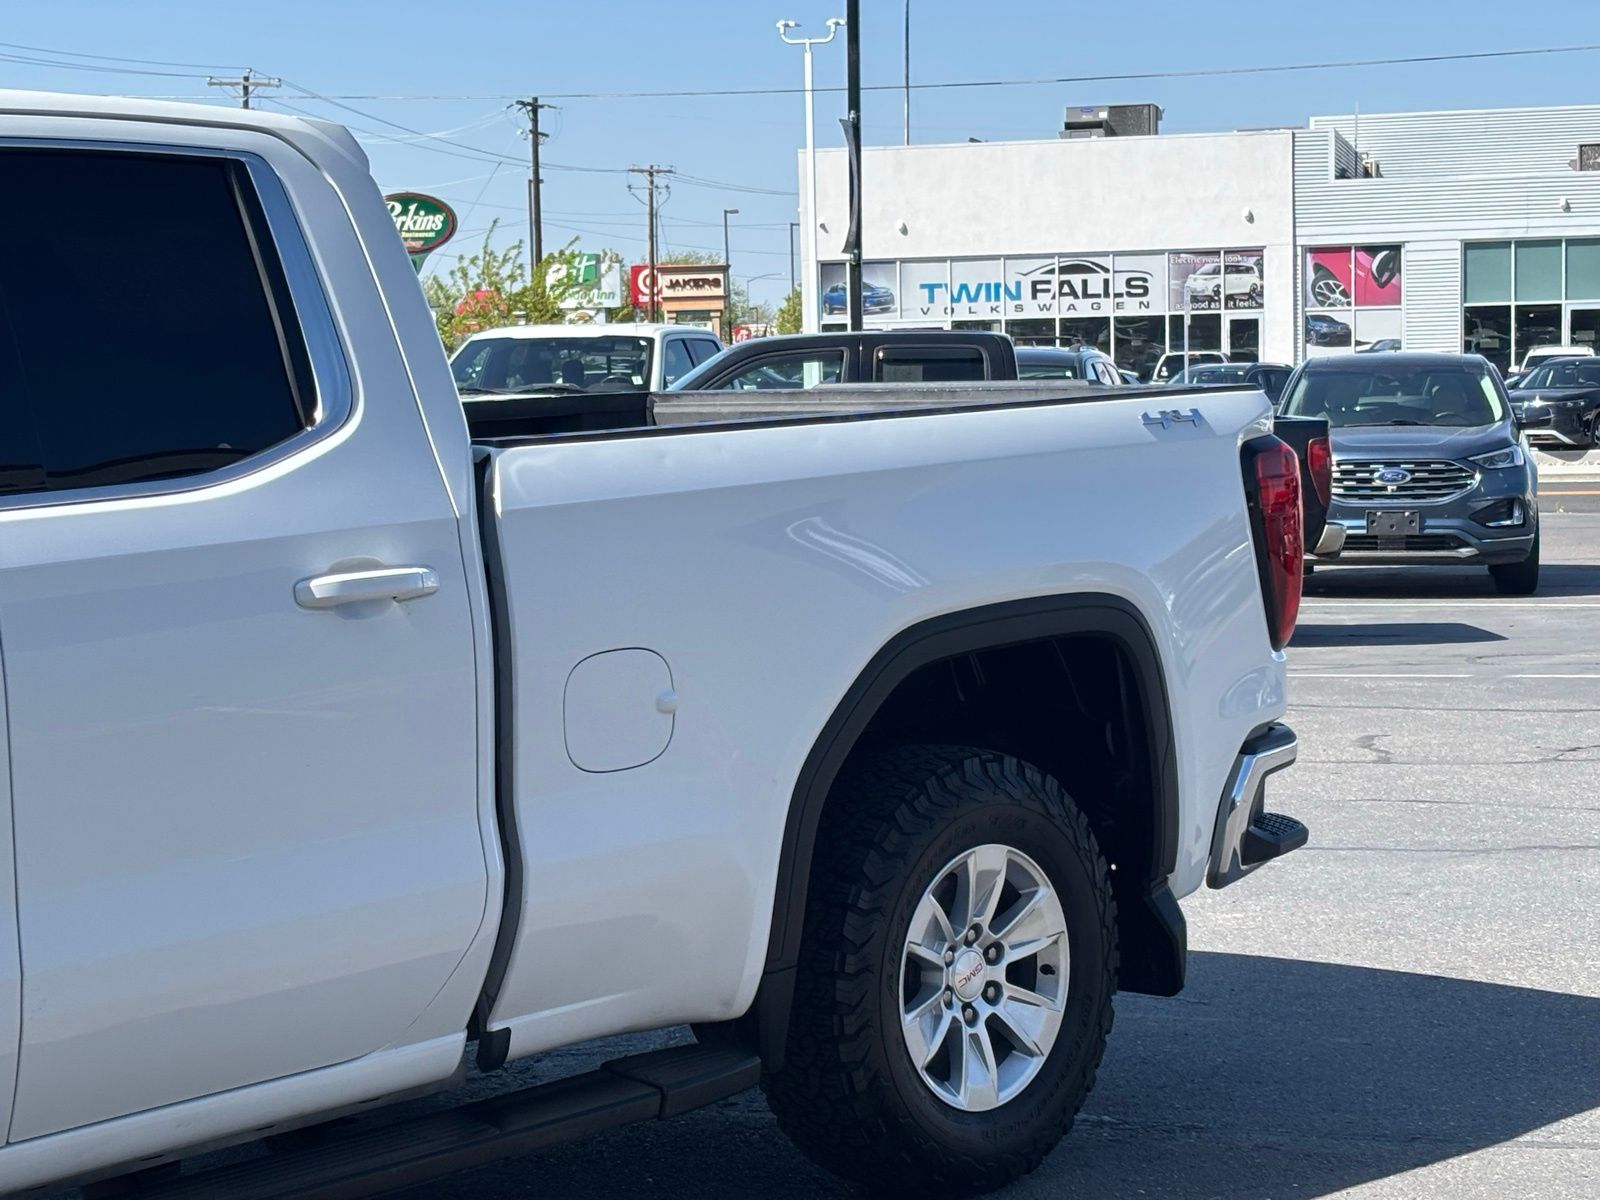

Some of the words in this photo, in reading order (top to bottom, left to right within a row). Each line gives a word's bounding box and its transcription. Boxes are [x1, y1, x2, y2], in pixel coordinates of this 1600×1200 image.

[1170, 255, 1201, 264] Electric
[665, 278, 722, 289] JAKERS
[919, 280, 1022, 304] TWIN
[1031, 276, 1150, 300] FALLS
[920, 300, 1151, 316] VOLKSWAGEN
[1210, 301, 1220, 309] as
[1227, 300, 1234, 308] it
[958, 962, 984, 988] GMC
